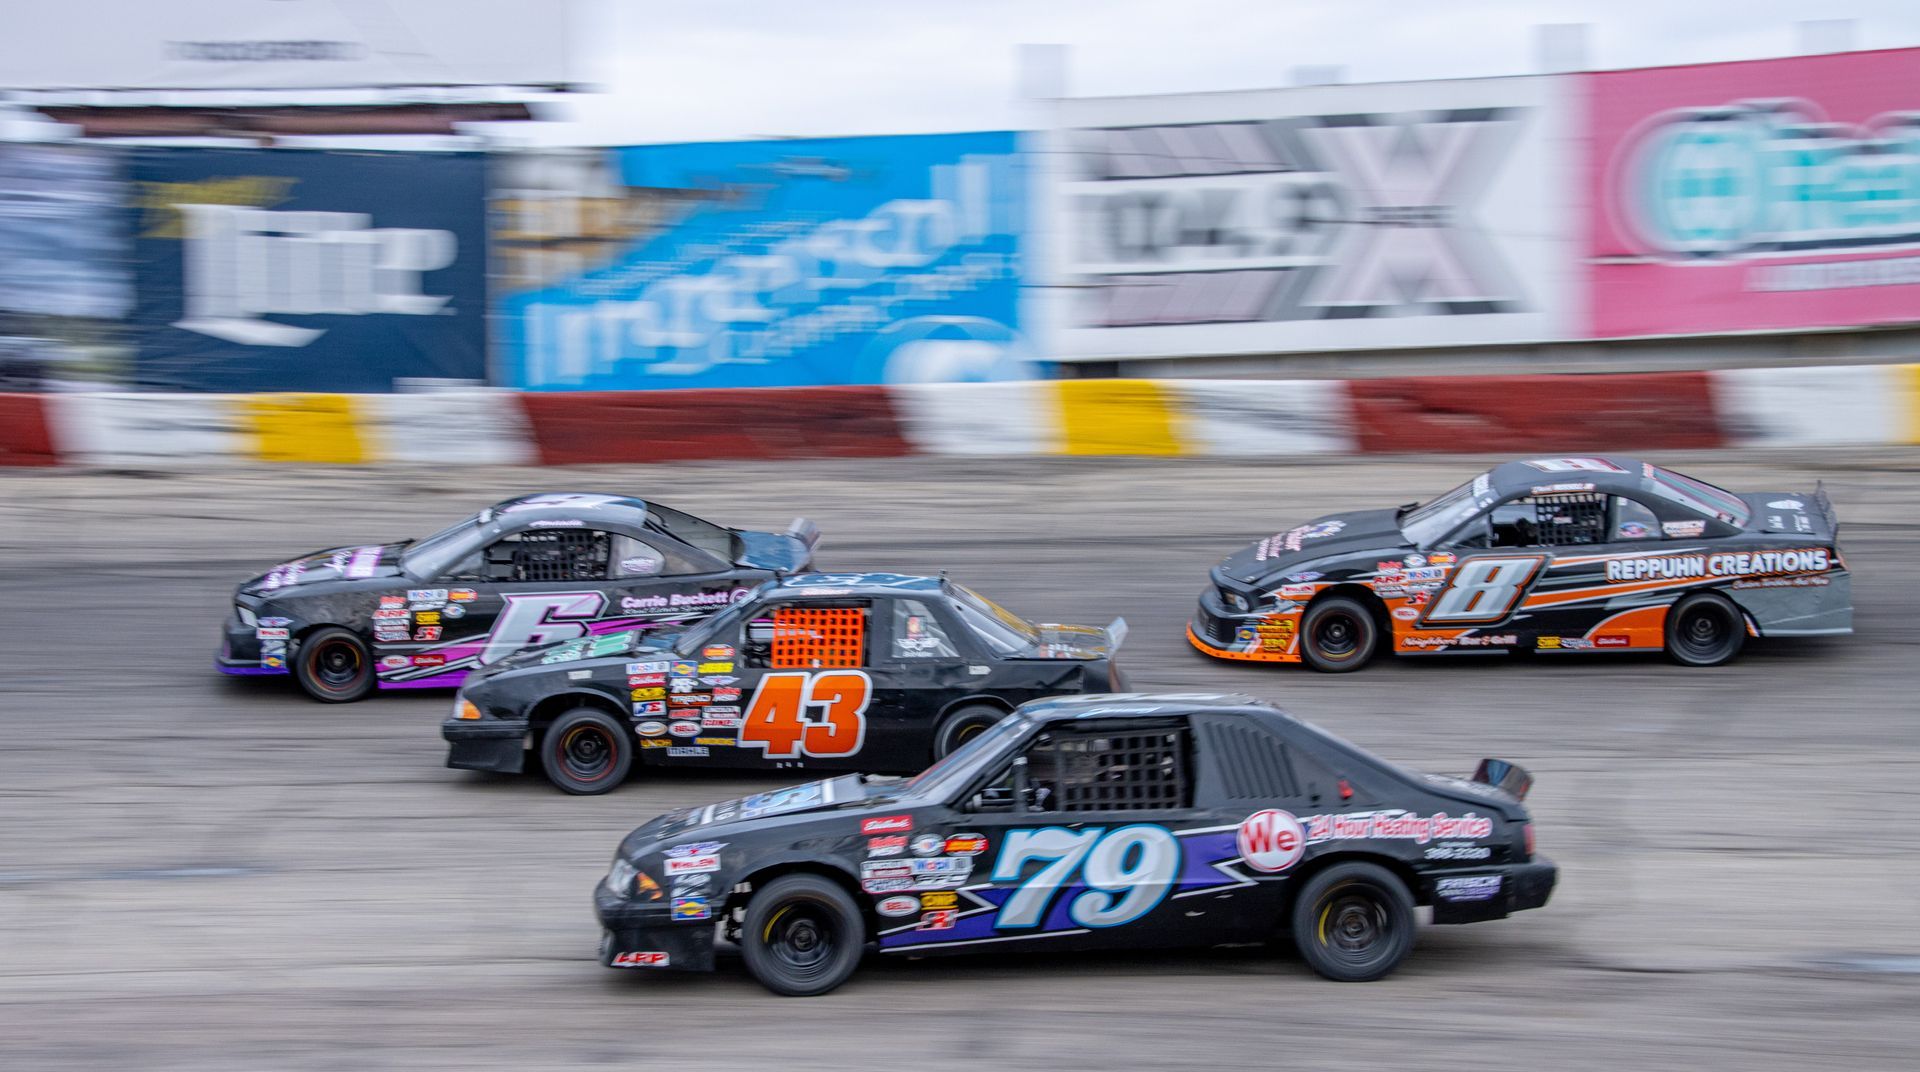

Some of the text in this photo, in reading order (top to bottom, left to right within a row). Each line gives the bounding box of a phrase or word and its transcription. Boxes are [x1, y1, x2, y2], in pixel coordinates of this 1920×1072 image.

[1416, 553, 1550, 627] 8
[1606, 549, 1829, 581] REPPUHN CREATIONS
[738, 670, 873, 759] 43
[1243, 811, 1296, 853] We
[1333, 816, 1369, 839] Hour
[1369, 812, 1430, 844] Heating
[1430, 812, 1492, 839] Service
[990, 823, 1182, 929] 79
